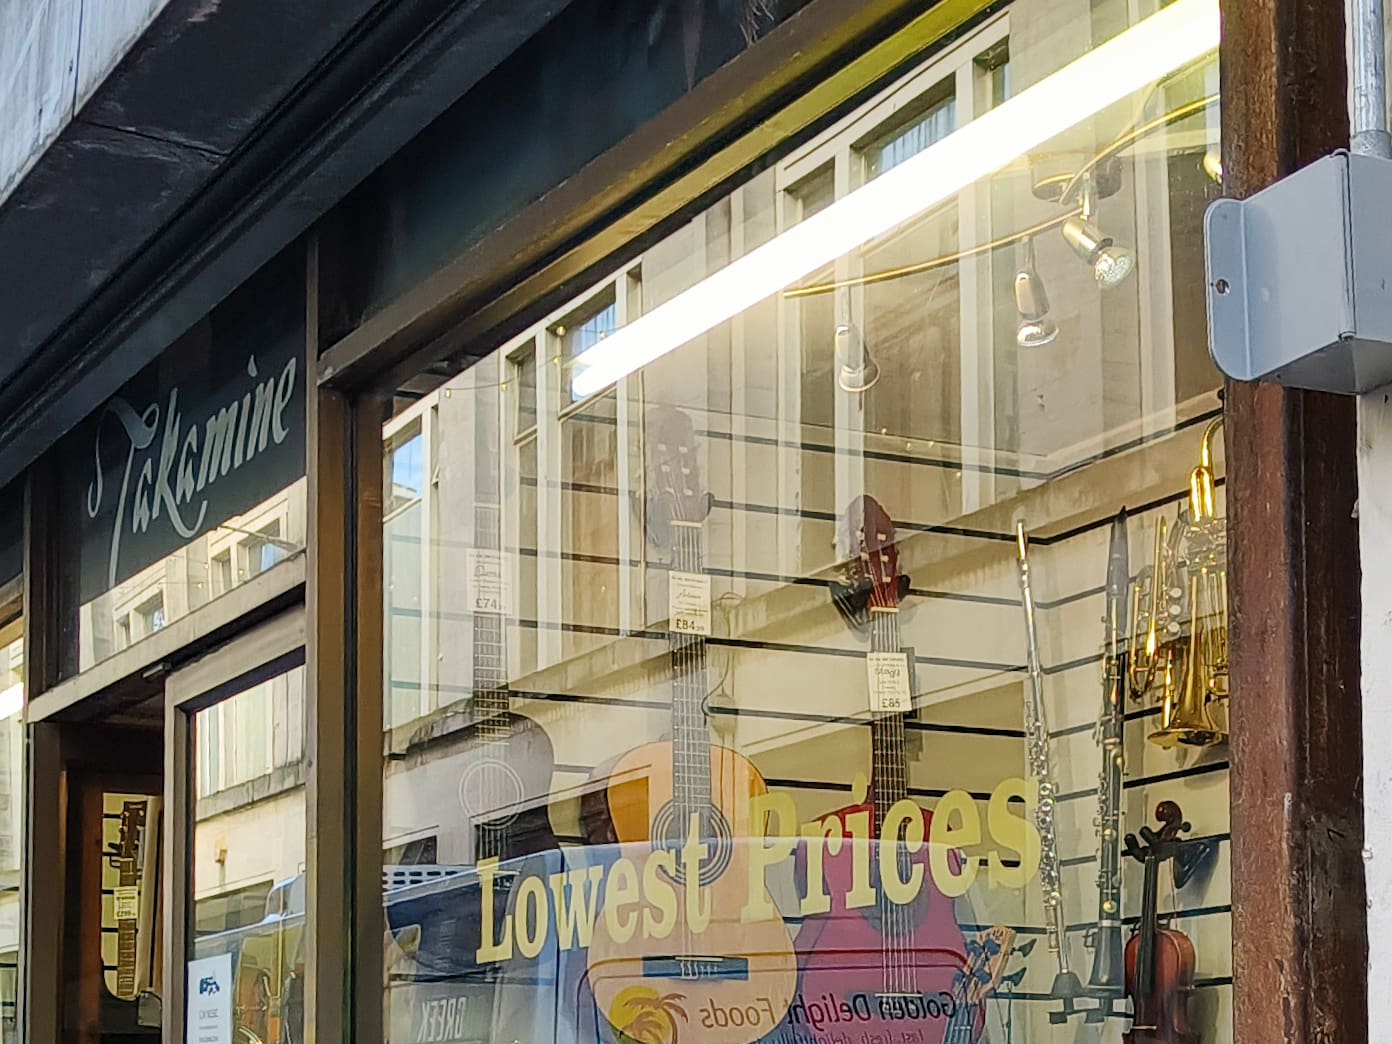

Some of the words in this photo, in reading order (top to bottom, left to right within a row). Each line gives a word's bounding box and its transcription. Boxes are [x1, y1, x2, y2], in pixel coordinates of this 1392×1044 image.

[88, 354, 297, 590] Takamine
[881, 697, 901, 708] £85
[474, 812, 712, 964] Lowest
[739, 771, 1043, 924] Prices
